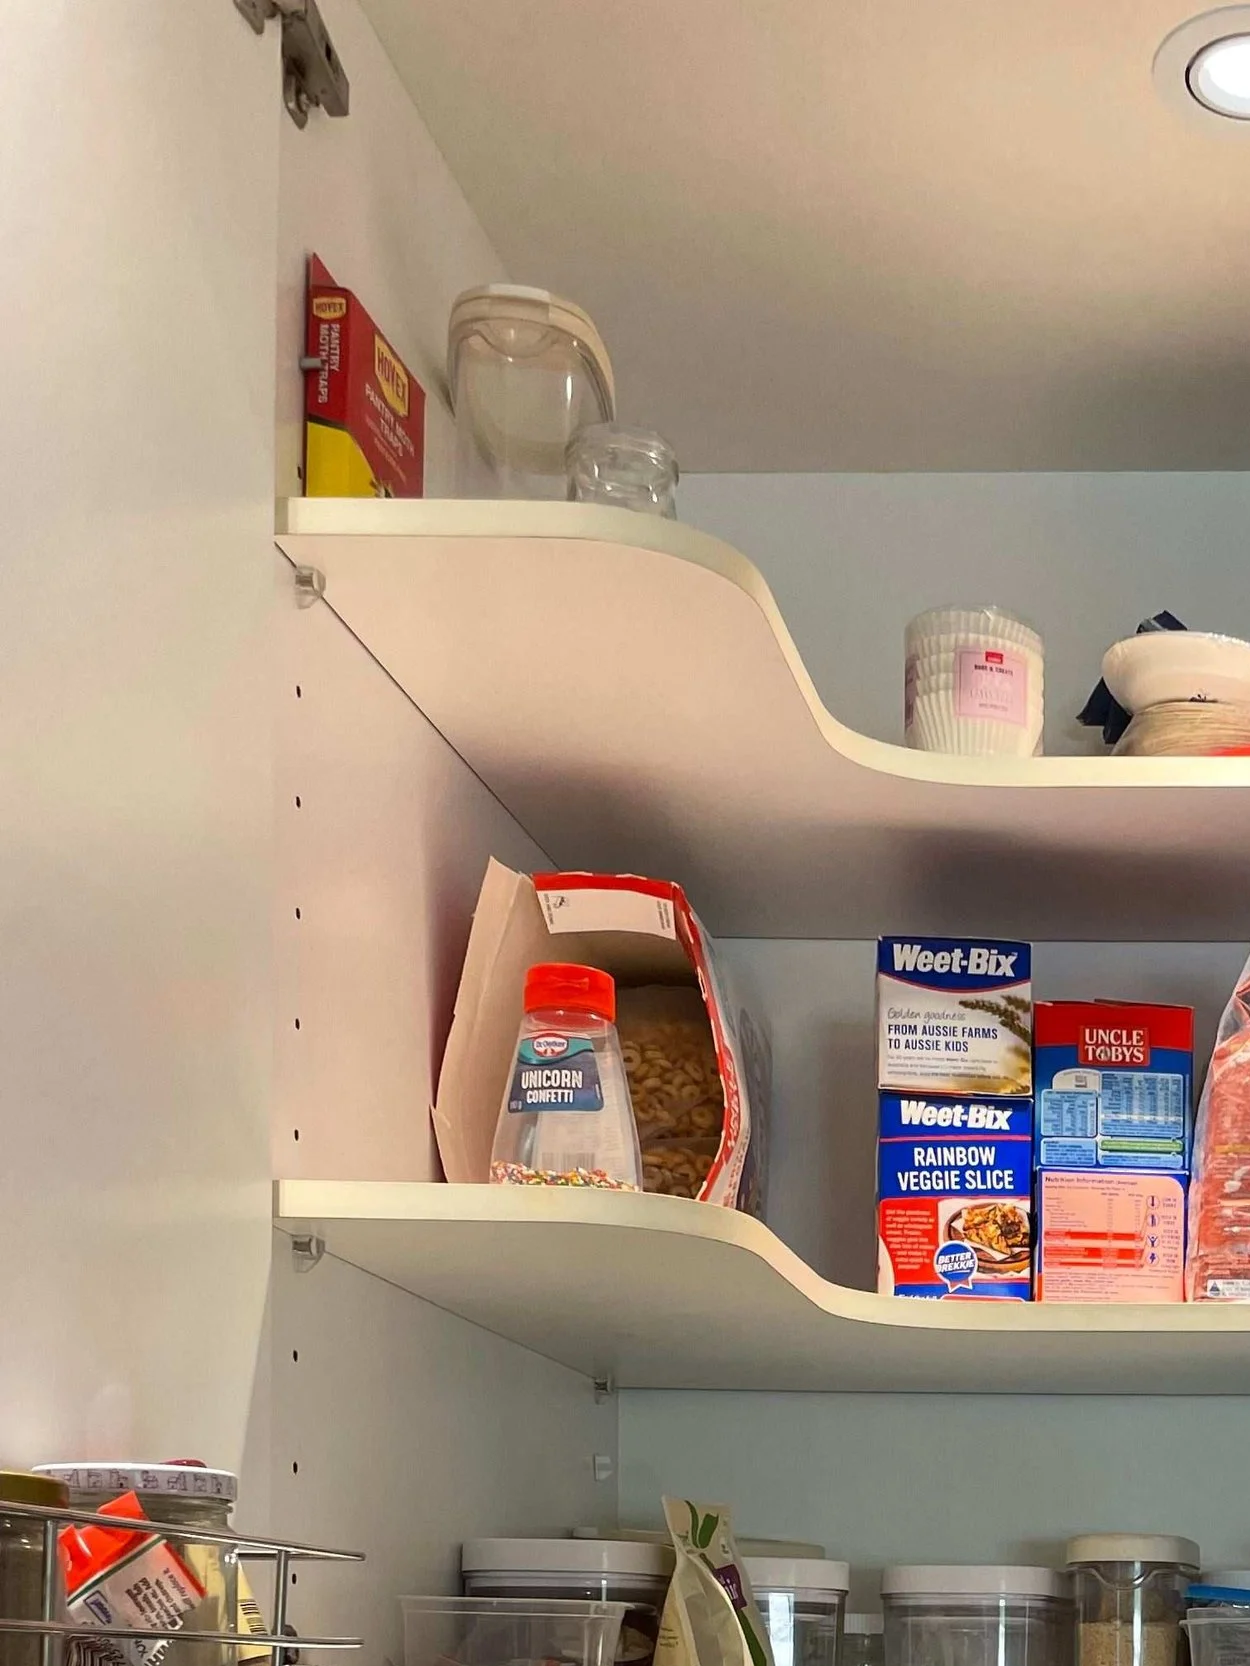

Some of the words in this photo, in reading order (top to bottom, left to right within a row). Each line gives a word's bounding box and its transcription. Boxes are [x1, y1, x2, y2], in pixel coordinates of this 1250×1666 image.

[893, 944, 1018, 977] Weet-Bix
[888, 1008, 920, 1020] Golden
[924, 1009, 965, 1023] goodness
[888, 1024, 917, 1036] FROM
[922, 1025, 957, 1037] AUSSIE
[962, 1027, 998, 1039] FARMS
[1085, 1029, 1144, 1046] UNCLE
[888, 1038, 900, 1049] TO
[905, 1039, 940, 1050] AUSSIE
[945, 1041, 968, 1052] KIDS
[1085, 1046, 1144, 1063] TOBYS
[521, 1070, 582, 1089] UNICORN
[527, 1090, 573, 1104] CONFETTI
[901, 1100, 1013, 1130] Weet-Bix
[914, 1147, 995, 1166] RAINBOW
[898, 1171, 960, 1191] VEGGIE
[965, 1170, 1013, 1190] SLICE
[938, 1252, 972, 1265] BETTER
